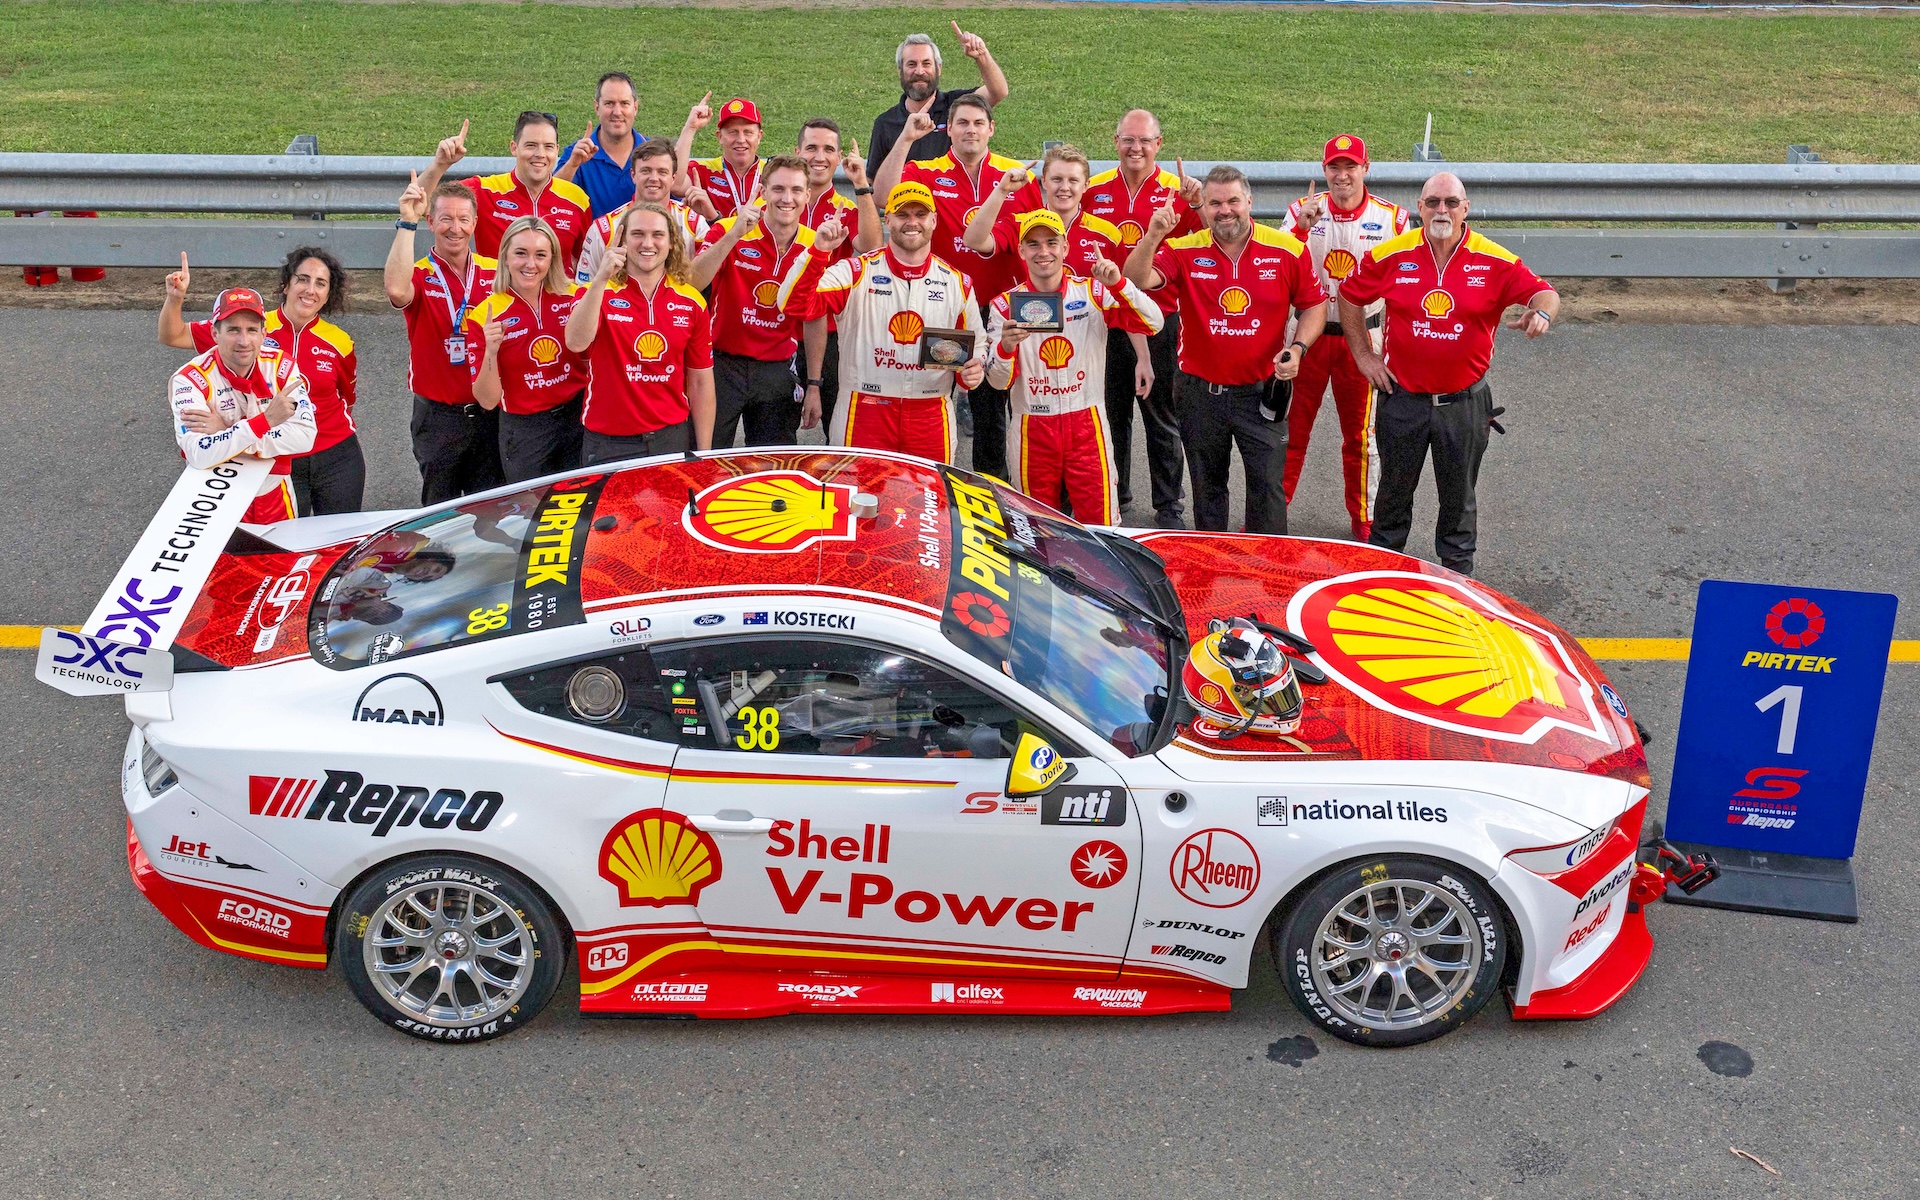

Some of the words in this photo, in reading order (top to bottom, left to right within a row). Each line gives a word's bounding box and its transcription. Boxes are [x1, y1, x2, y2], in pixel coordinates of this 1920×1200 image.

[892, 186, 930, 200] DUNLOP
[939, 190, 959, 198] Repco
[1024, 214, 1058, 226] DUNLOP
[1197, 272, 1218, 280] Repco
[1468, 277, 1485, 285] DXC
[928, 291, 944, 299] DXC
[673, 316, 689, 324] DXC
[743, 307, 756, 316] Shell
[742, 316, 780, 328] V-Power
[1209, 318, 1227, 327] Shell
[1210, 327, 1257, 336] V-Power
[1413, 328, 1460, 340] V-Power
[874, 348, 895, 357] Shell
[316, 360, 332, 369] DXC
[524, 372, 543, 380] Shell
[526, 373, 569, 390] V-Power
[627, 372, 670, 382] V-Power
[1029, 383, 1082, 396] V-Power
[220, 398, 235, 408] DXC
[919, 487, 939, 530] V-Power
[525, 492, 588, 589] PIRTEK
[946, 471, 1010, 602] PIRTEK
[94, 578, 184, 648] DXC
[151, 460, 244, 573] TECHNOLOGY
[919, 530, 940, 570] Shell
[1017, 562, 1042, 585] 38
[528, 593, 543, 628] 1980
[546, 596, 557, 618] EST.
[466, 603, 509, 635] 38
[610, 617, 651, 636] QLD
[699, 614, 721, 626] Ford
[775, 611, 855, 630] KOSTECKI
[612, 633, 653, 644] FORKLIFTS
[53, 631, 146, 678] DXC
[1741, 651, 1837, 674] PIRTEK
[52, 666, 141, 691] TECHNOLOGY
[360, 708, 437, 725] MAN
[684, 717, 698, 725] Kayo
[1754, 684, 1803, 754] 1
[736, 706, 780, 751] 38
[1039, 761, 1064, 785] Doric
[304, 769, 504, 837] Repco
[1059, 789, 1112, 818] nti
[1293, 800, 1392, 821] national
[1397, 802, 1448, 823] tiles
[1728, 806, 1797, 816] CHAMPIONSHIP
[1730, 800, 1798, 811] SUPERCARS
[1741, 813, 1795, 829] Repco
[161, 835, 211, 858] Jet
[765, 818, 891, 864] Shell
[1578, 827, 1606, 858] mps
[161, 854, 210, 868] COURIERS
[1180, 832, 1254, 894] Rheem
[386, 868, 442, 894] SPORT
[765, 866, 1094, 932] V-Power
[219, 899, 292, 930] FORD
[217, 912, 290, 939] PERFORMANCE
[1157, 920, 1245, 940] DUNLOP
[589, 947, 626, 967] PPG
[1169, 944, 1227, 965] Repco
[634, 982, 708, 994] octane
[777, 983, 862, 998] ROADX
[957, 984, 1004, 999] alfex
[1073, 987, 1147, 1002] REVOLUTION
[1296, 948, 1347, 1028] DUNLOP
[802, 993, 836, 1002] TYRES
[1100, 1000, 1142, 1008] RACEGEAR
[395, 1018, 499, 1040] DUNLOP
